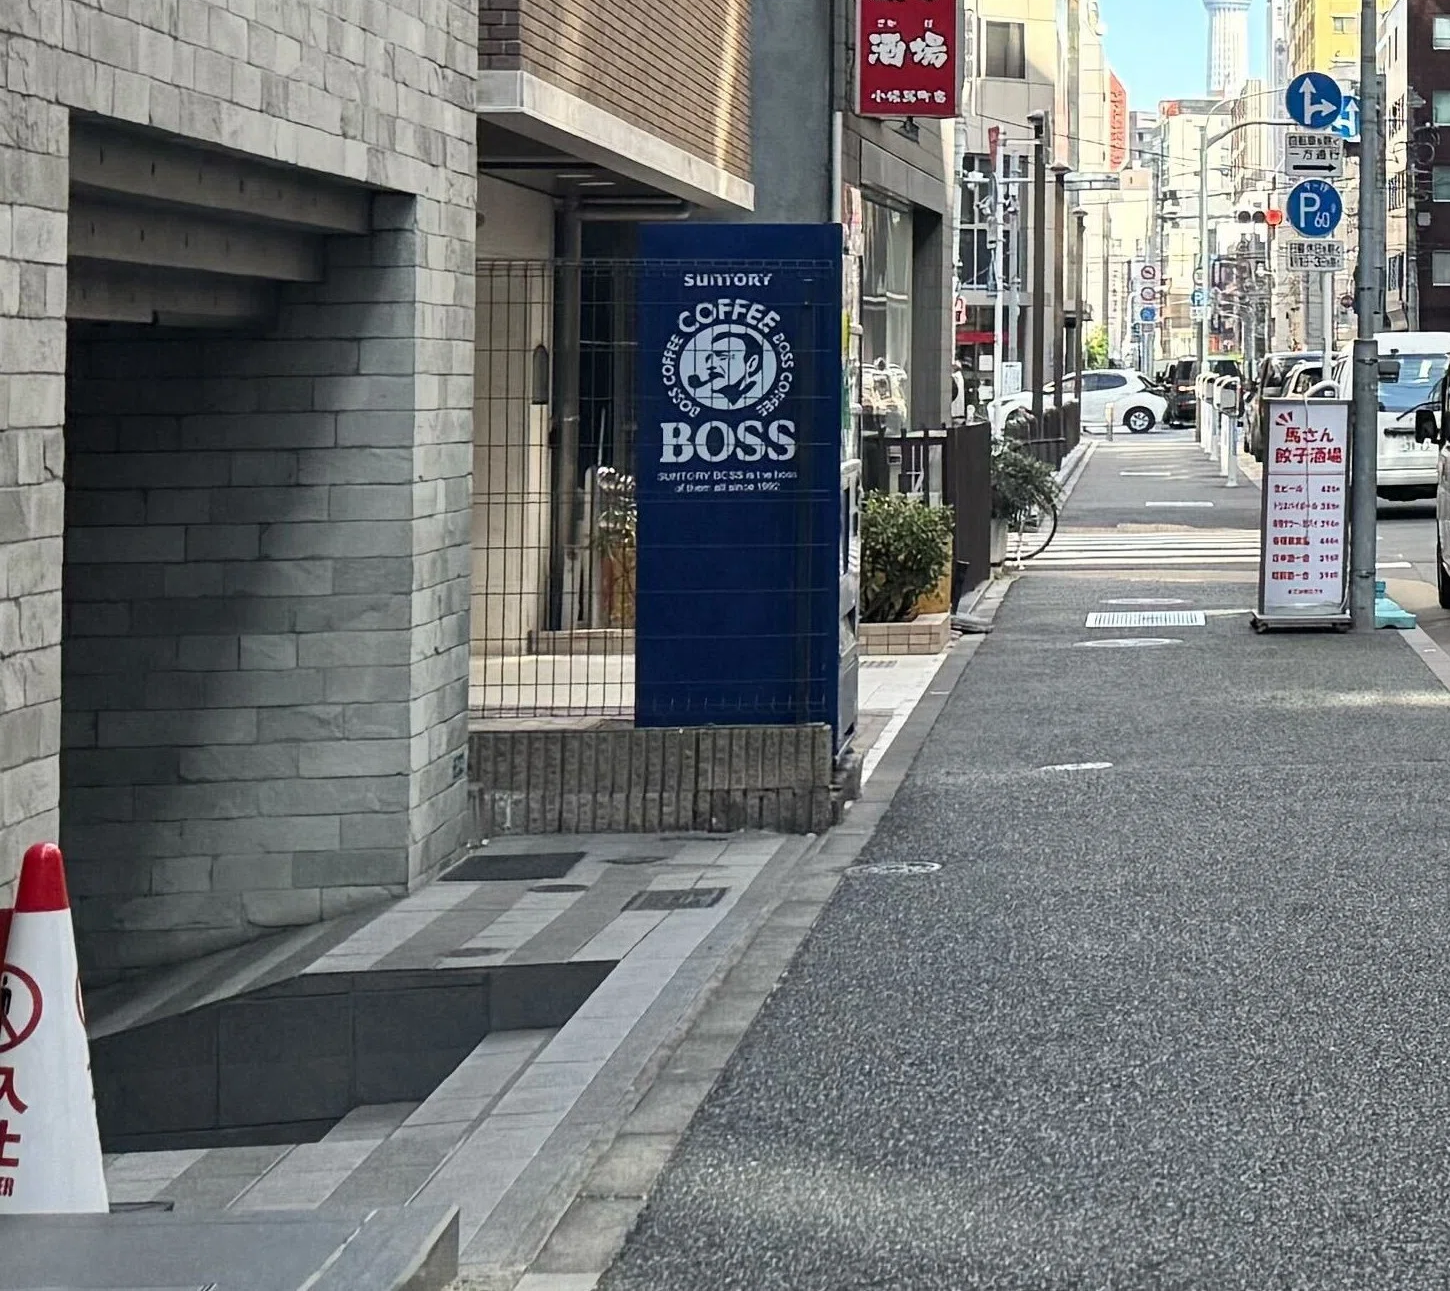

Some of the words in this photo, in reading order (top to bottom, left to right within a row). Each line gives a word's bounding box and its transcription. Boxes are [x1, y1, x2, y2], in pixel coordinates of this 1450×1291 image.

[868, 31, 948, 69] 酒場
[1289, 149, 1340, 161] 一方通行
[1300, 192, 1321, 228] P
[683, 272, 773, 287] SUNTORY
[677, 298, 781, 334] COFFEE
[661, 334, 684, 386] COFFEE
[772, 332, 794, 369] BOSS
[757, 371, 793, 417] COFFEE
[659, 419, 797, 463] BOSS
[1284, 427, 1334, 443] 馬さん
[1275, 447, 1342, 463] 餃子酒場
[713, 471, 744, 481] BOSS
